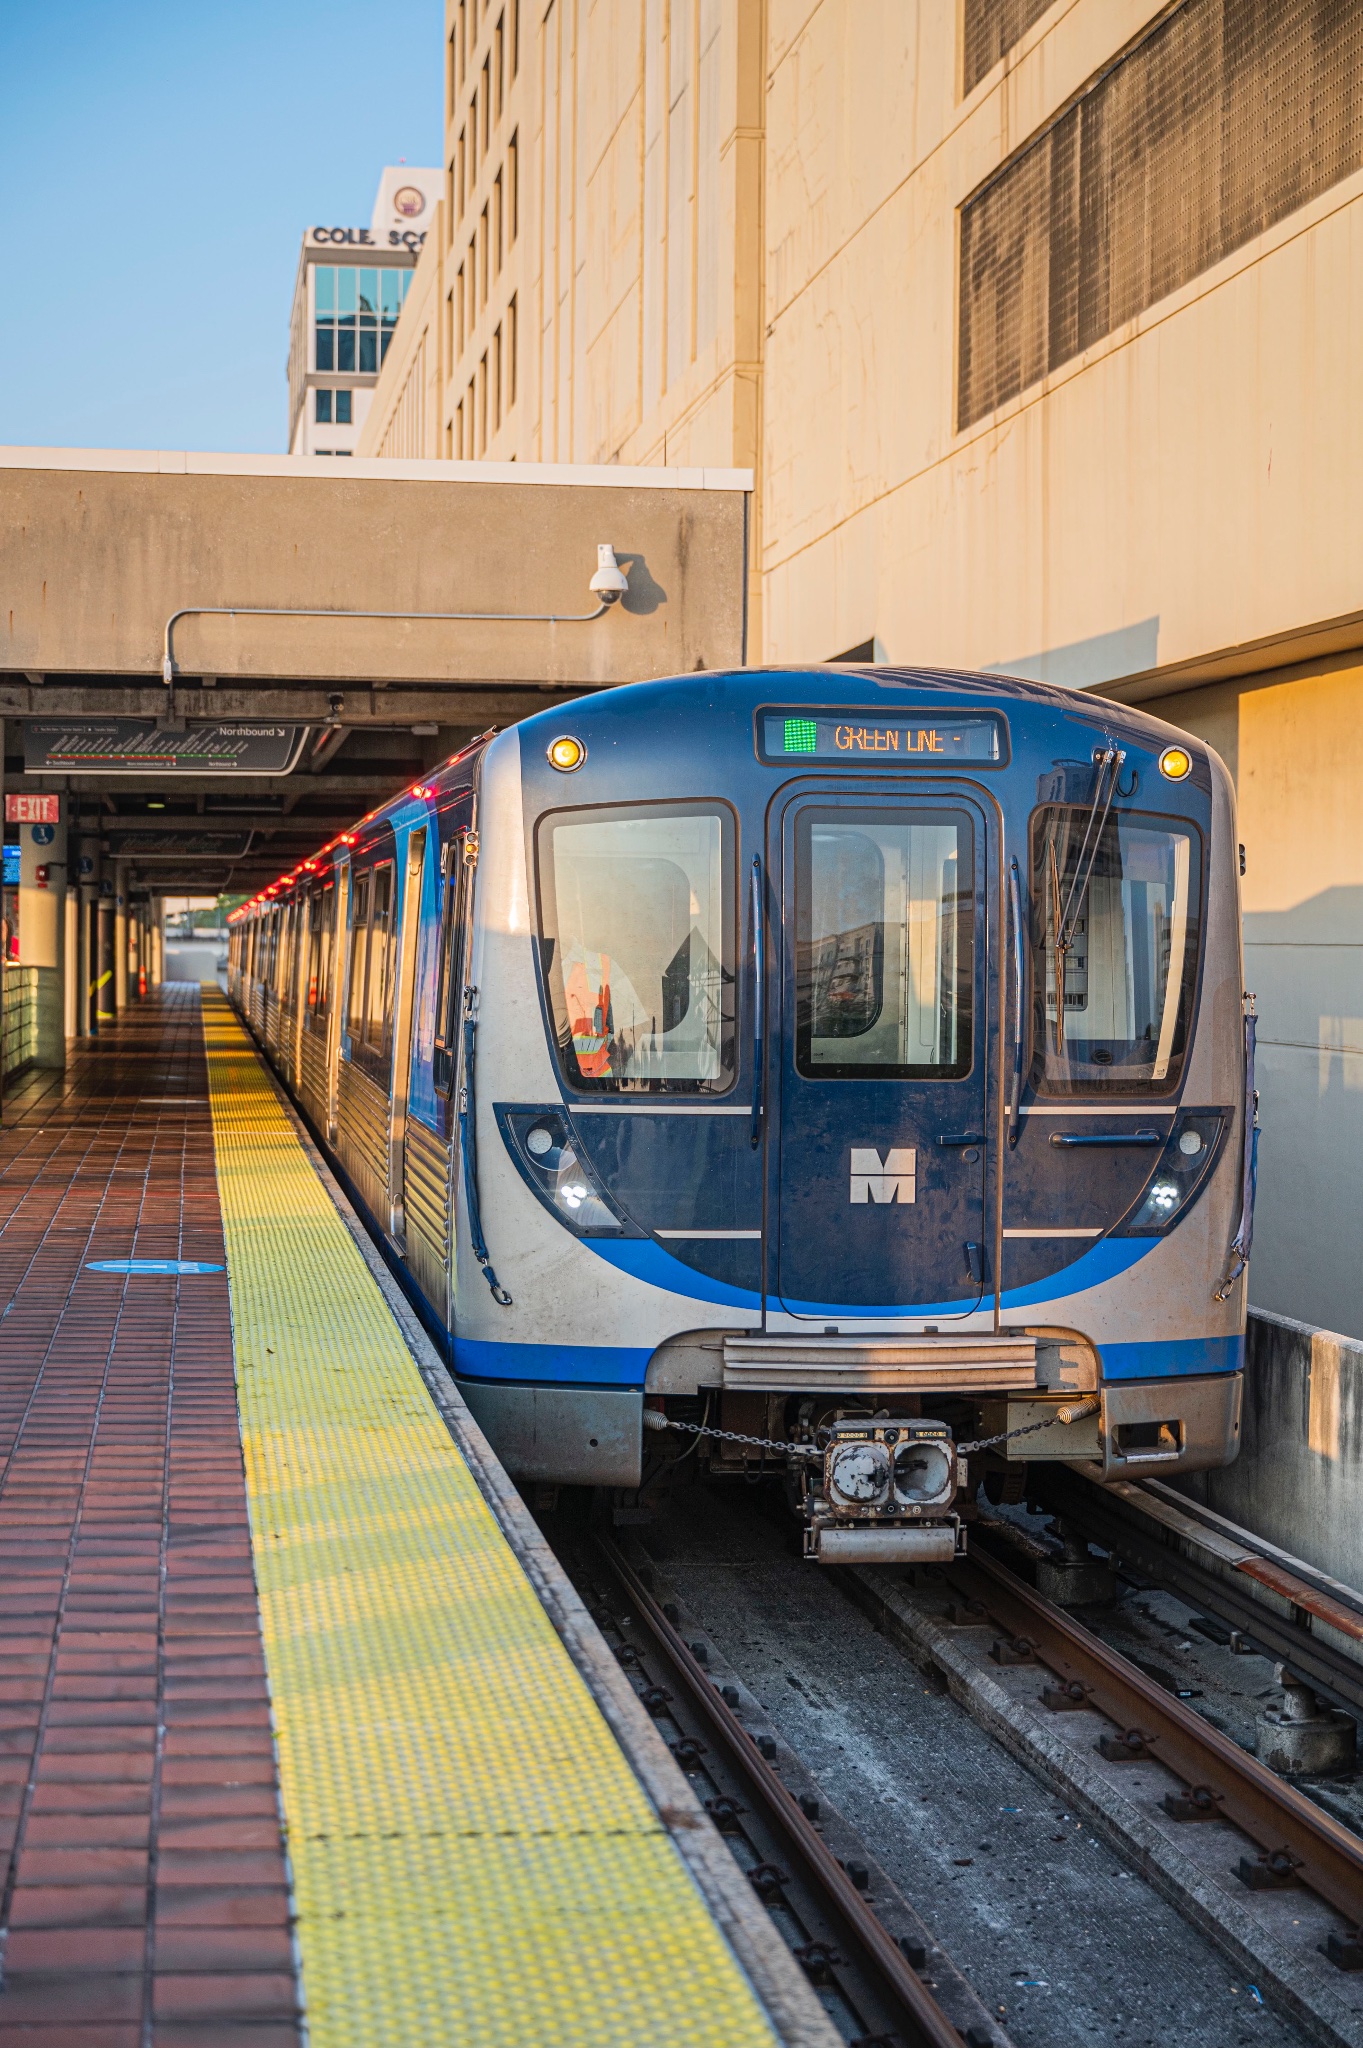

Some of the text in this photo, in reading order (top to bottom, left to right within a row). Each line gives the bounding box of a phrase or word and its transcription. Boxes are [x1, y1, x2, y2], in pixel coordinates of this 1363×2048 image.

[219, 727, 275, 736] Northbound
[835, 725, 899, 751] GREEN
[907, 729, 944, 752] LINE
[17, 797, 50, 821] EXIT
[850, 1147, 917, 1204] M
